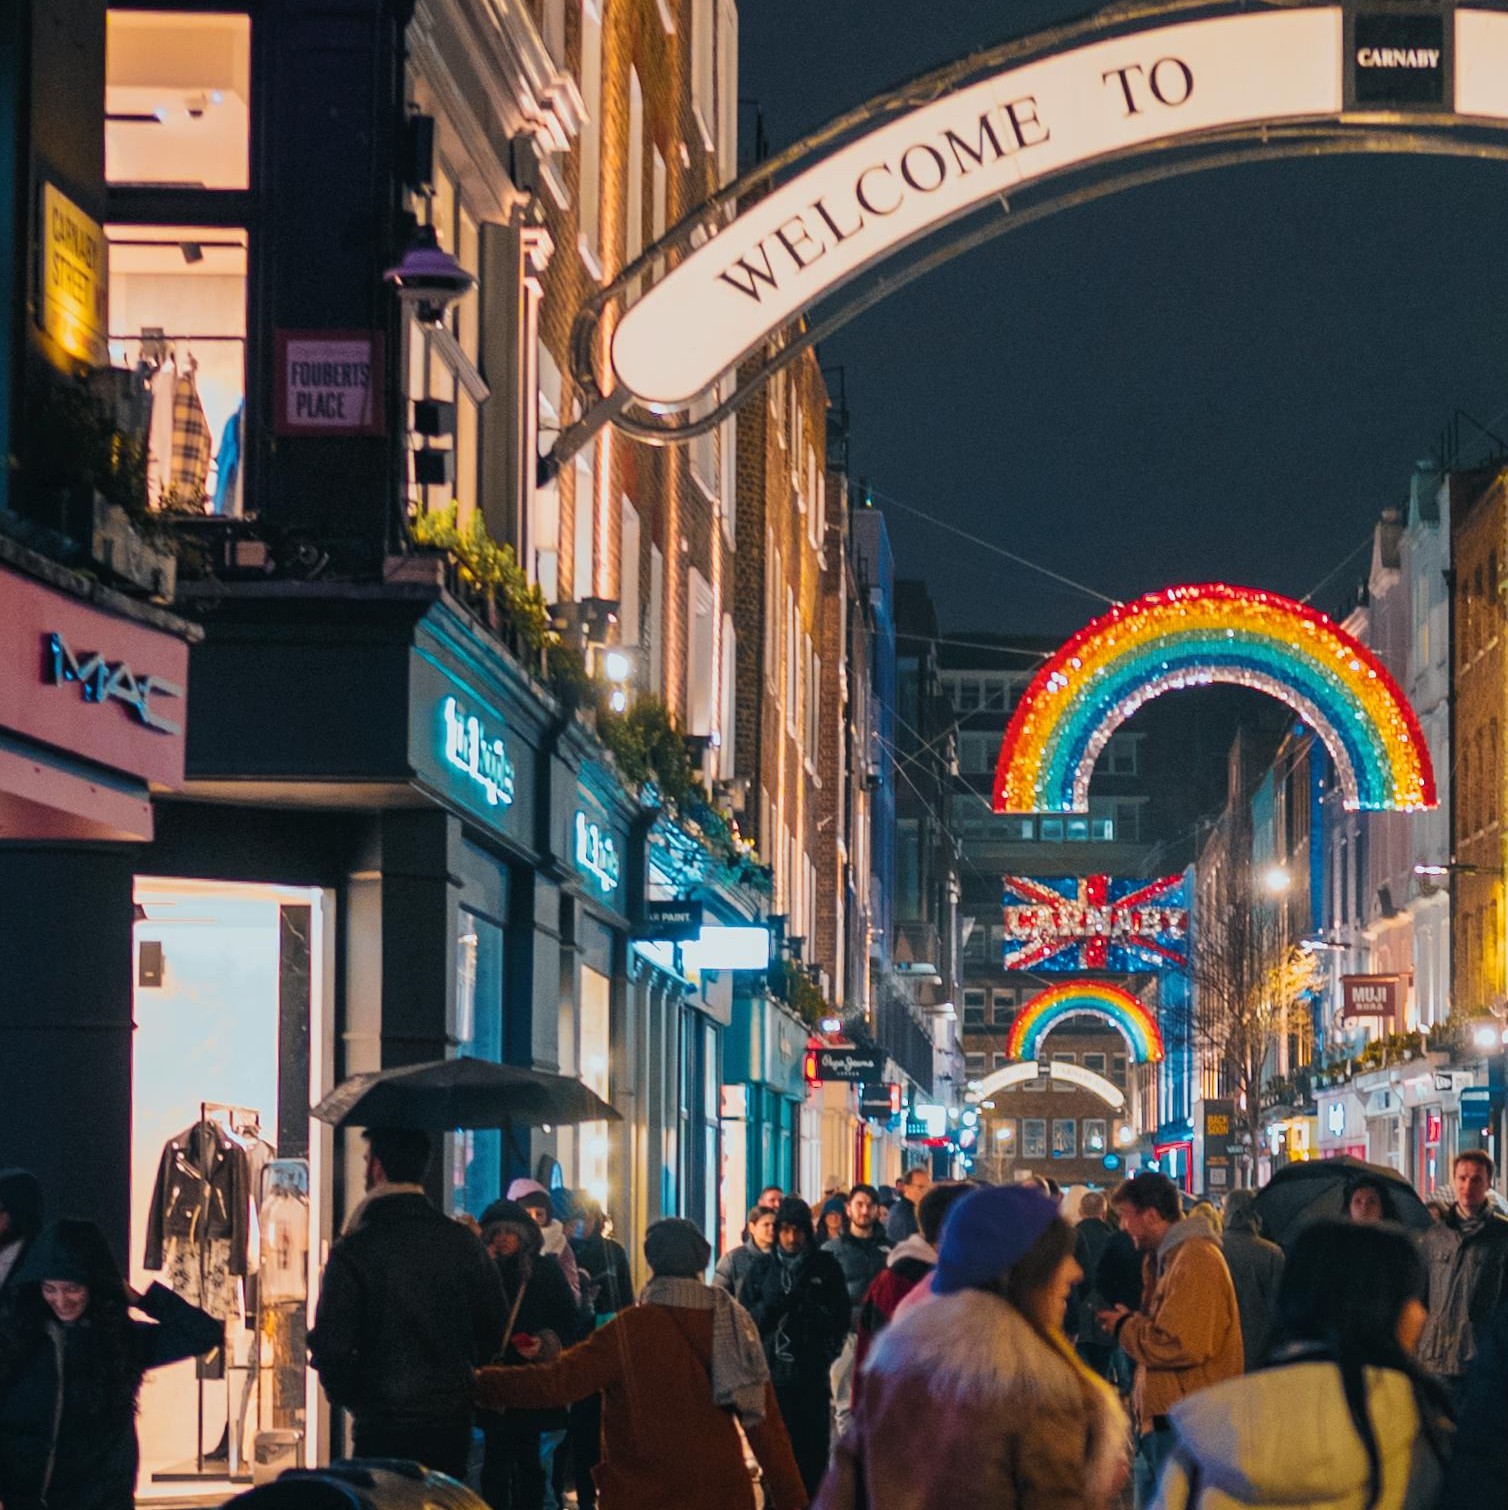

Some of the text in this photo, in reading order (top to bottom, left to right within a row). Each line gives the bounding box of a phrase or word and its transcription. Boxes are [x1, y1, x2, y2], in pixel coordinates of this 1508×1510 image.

[1356, 47, 1441, 69] CARNABY
[714, 95, 1051, 304] WELCOME
[1103, 57, 1195, 118] TO
[52, 206, 97, 269] CARNABY
[53, 251, 91, 308] STREET
[291, 361, 369, 387] FOUBERTS
[296, 391, 346, 420] PLACE
[1352, 986, 1388, 1003] MUJI
